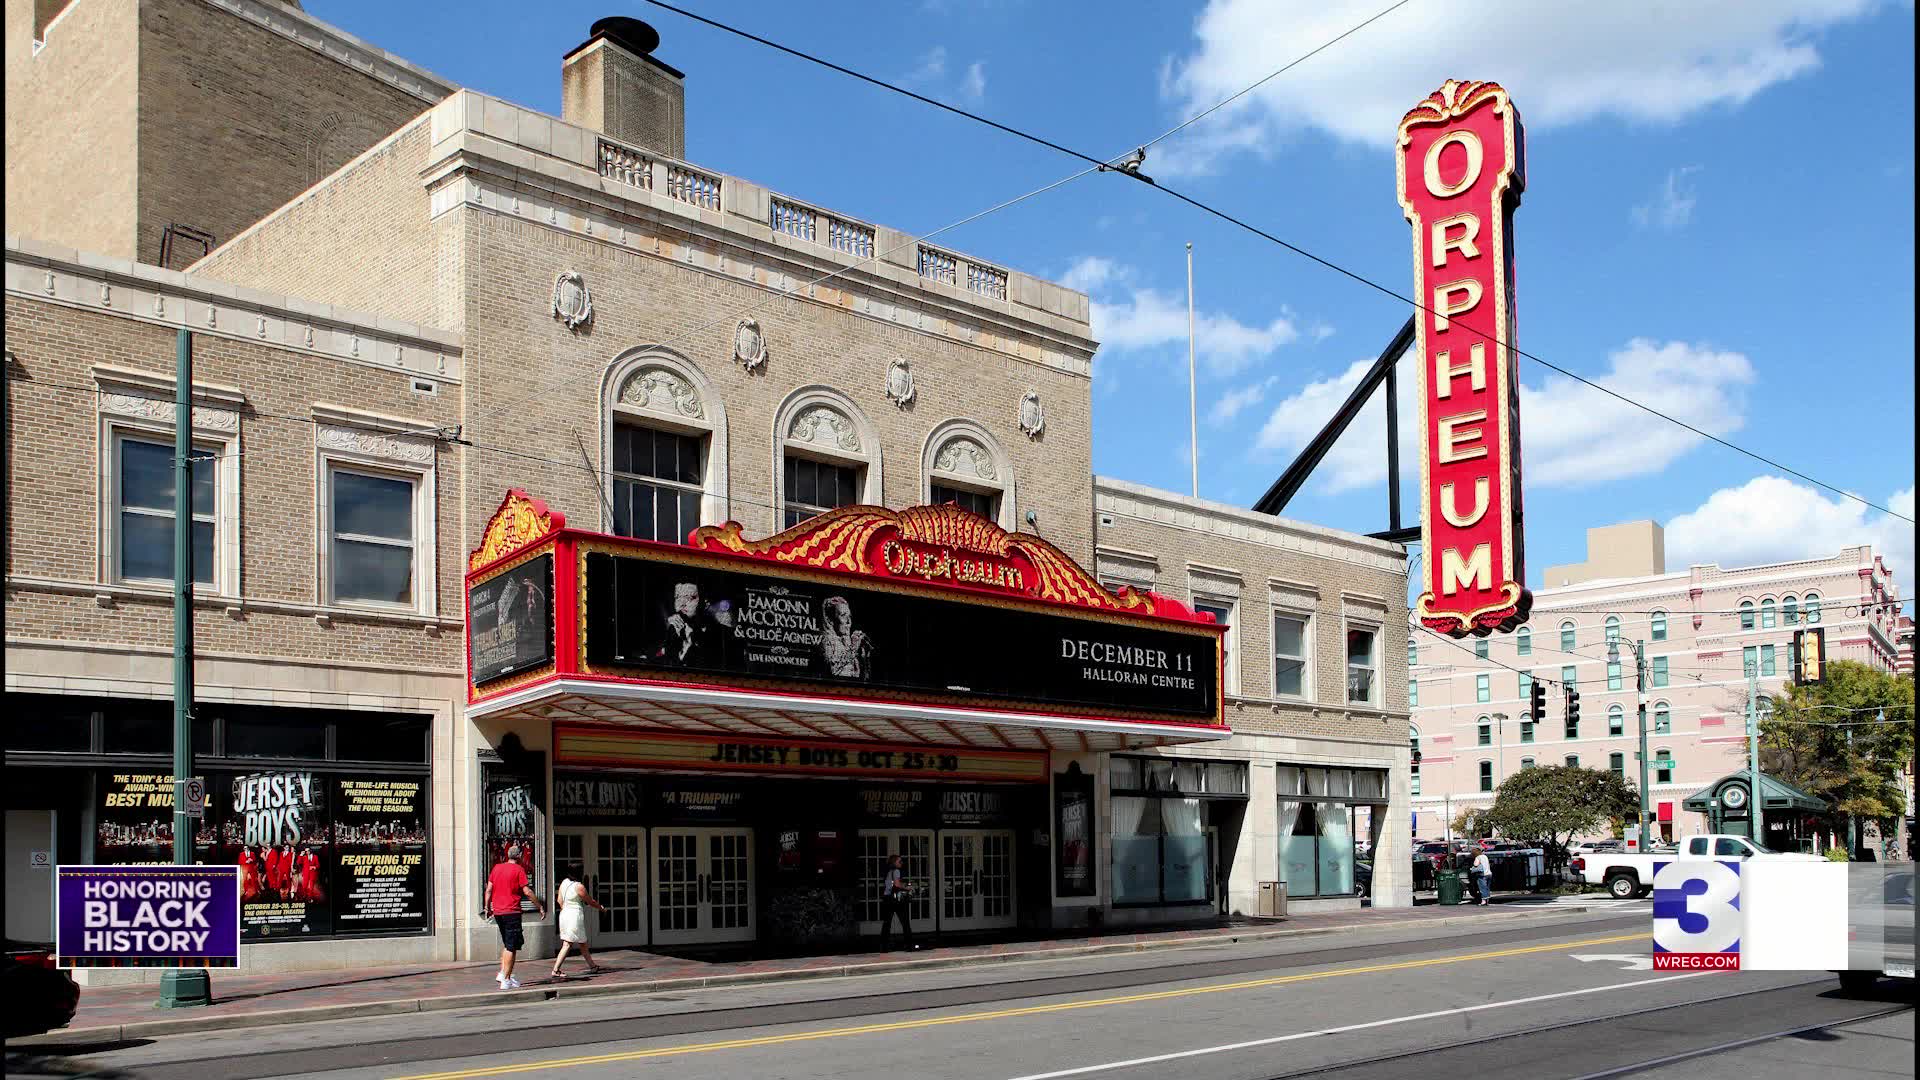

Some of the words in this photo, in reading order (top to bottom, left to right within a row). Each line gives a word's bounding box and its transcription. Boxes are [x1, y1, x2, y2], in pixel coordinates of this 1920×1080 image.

[1423, 129, 1491, 596] ORPHEUM
[883, 540, 1023, 589] Orpheum
[748, 593, 809, 614] EAMONN
[734, 625, 746, 638] &
[782, 631, 823, 645] AGNEW
[748, 653, 763, 662] LIVE
[1061, 638, 1168, 669] DECEMBER
[1176, 653, 1192, 672] 11
[1083, 667, 1148, 685] HALLORAN
[1151, 674, 1195, 689] CENTRE
[711, 743, 790, 764] JERSEY
[800, 748, 848, 767] BOYS
[858, 751, 894, 768] OCT
[113, 775, 130, 783] THE
[156, 775, 163, 783] &
[390, 782, 419, 790] MUSICAL
[105, 793, 145, 807] BEST
[233, 772, 312, 813] JERSEY
[344, 789, 393, 797] PHENOMENON
[383, 797, 401, 805] VALLI
[489, 786, 534, 816] JERSEY
[555, 781, 594, 806] RSEY
[599, 782, 640, 808] BOYS
[938, 791, 981, 813] JERSEY
[245, 805, 302, 847] BOYS
[495, 810, 527, 838] BOYS
[341, 855, 400, 865] FEATURING
[402, 854, 422, 865] THE
[353, 866, 372, 876] HIT
[373, 865, 410, 875] SONGS
